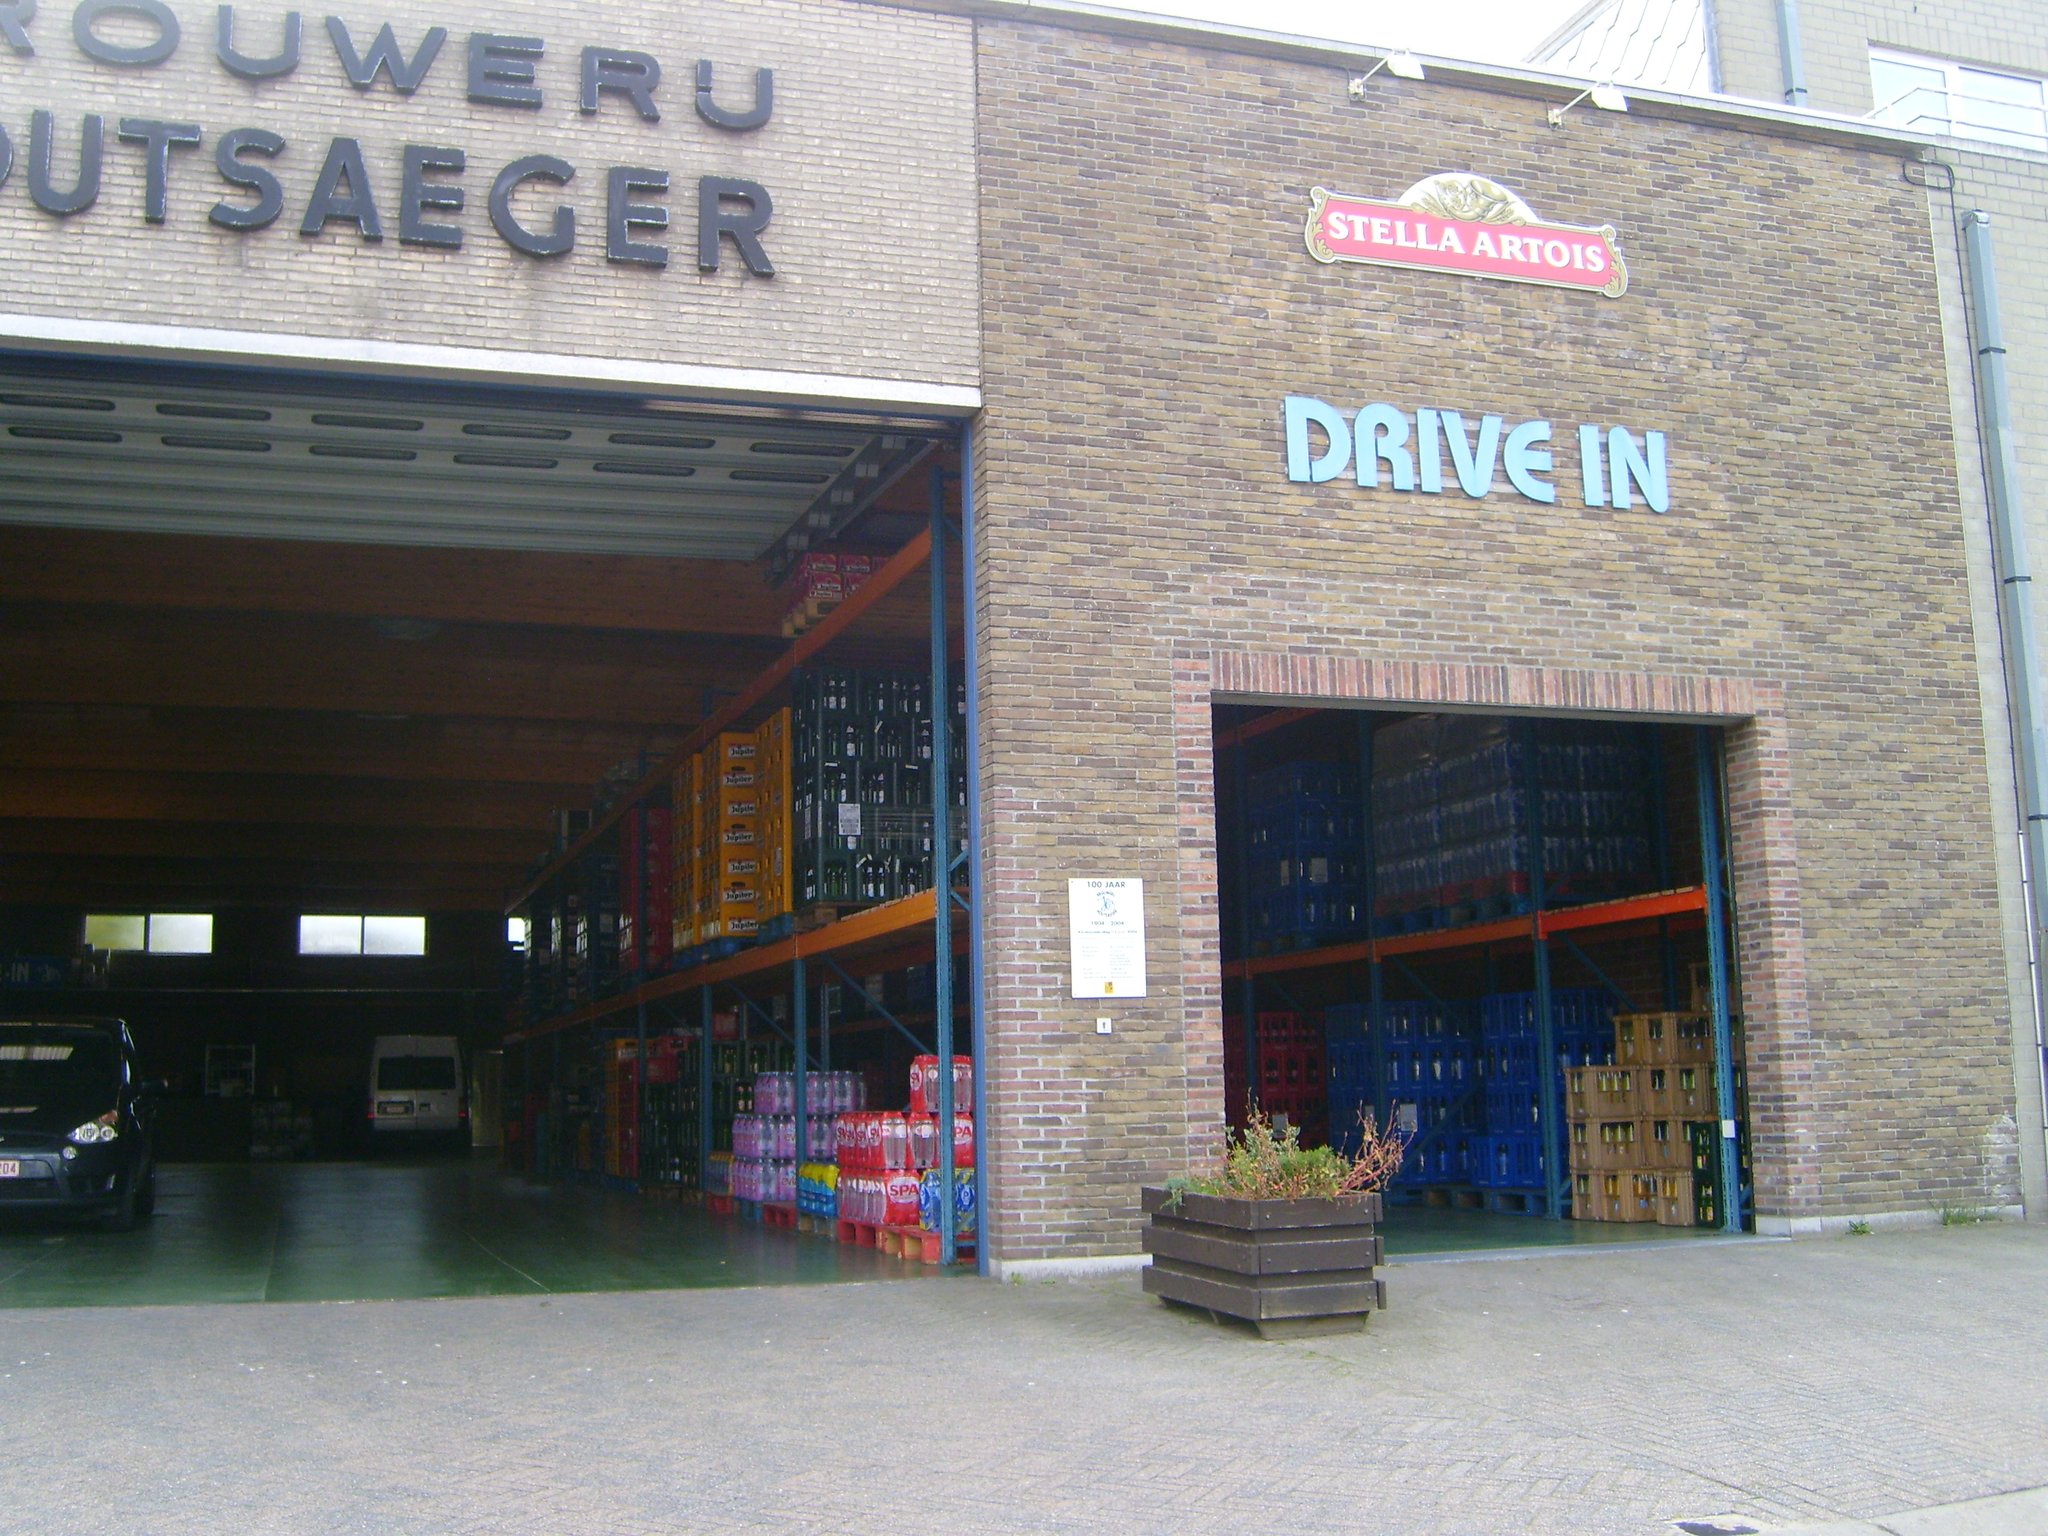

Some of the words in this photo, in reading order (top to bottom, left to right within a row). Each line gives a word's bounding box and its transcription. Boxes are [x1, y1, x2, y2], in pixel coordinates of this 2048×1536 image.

[0, 109, 776, 278] UTSAEGER
[1327, 210, 1466, 255] STELLA
[1471, 231, 1606, 273] ARTOIS
[1283, 394, 1556, 504] DRIVE
[1578, 423, 1670, 514] IN
[1087, 881, 1103, 889] 100
[889, 1184, 919, 1197] SPA
